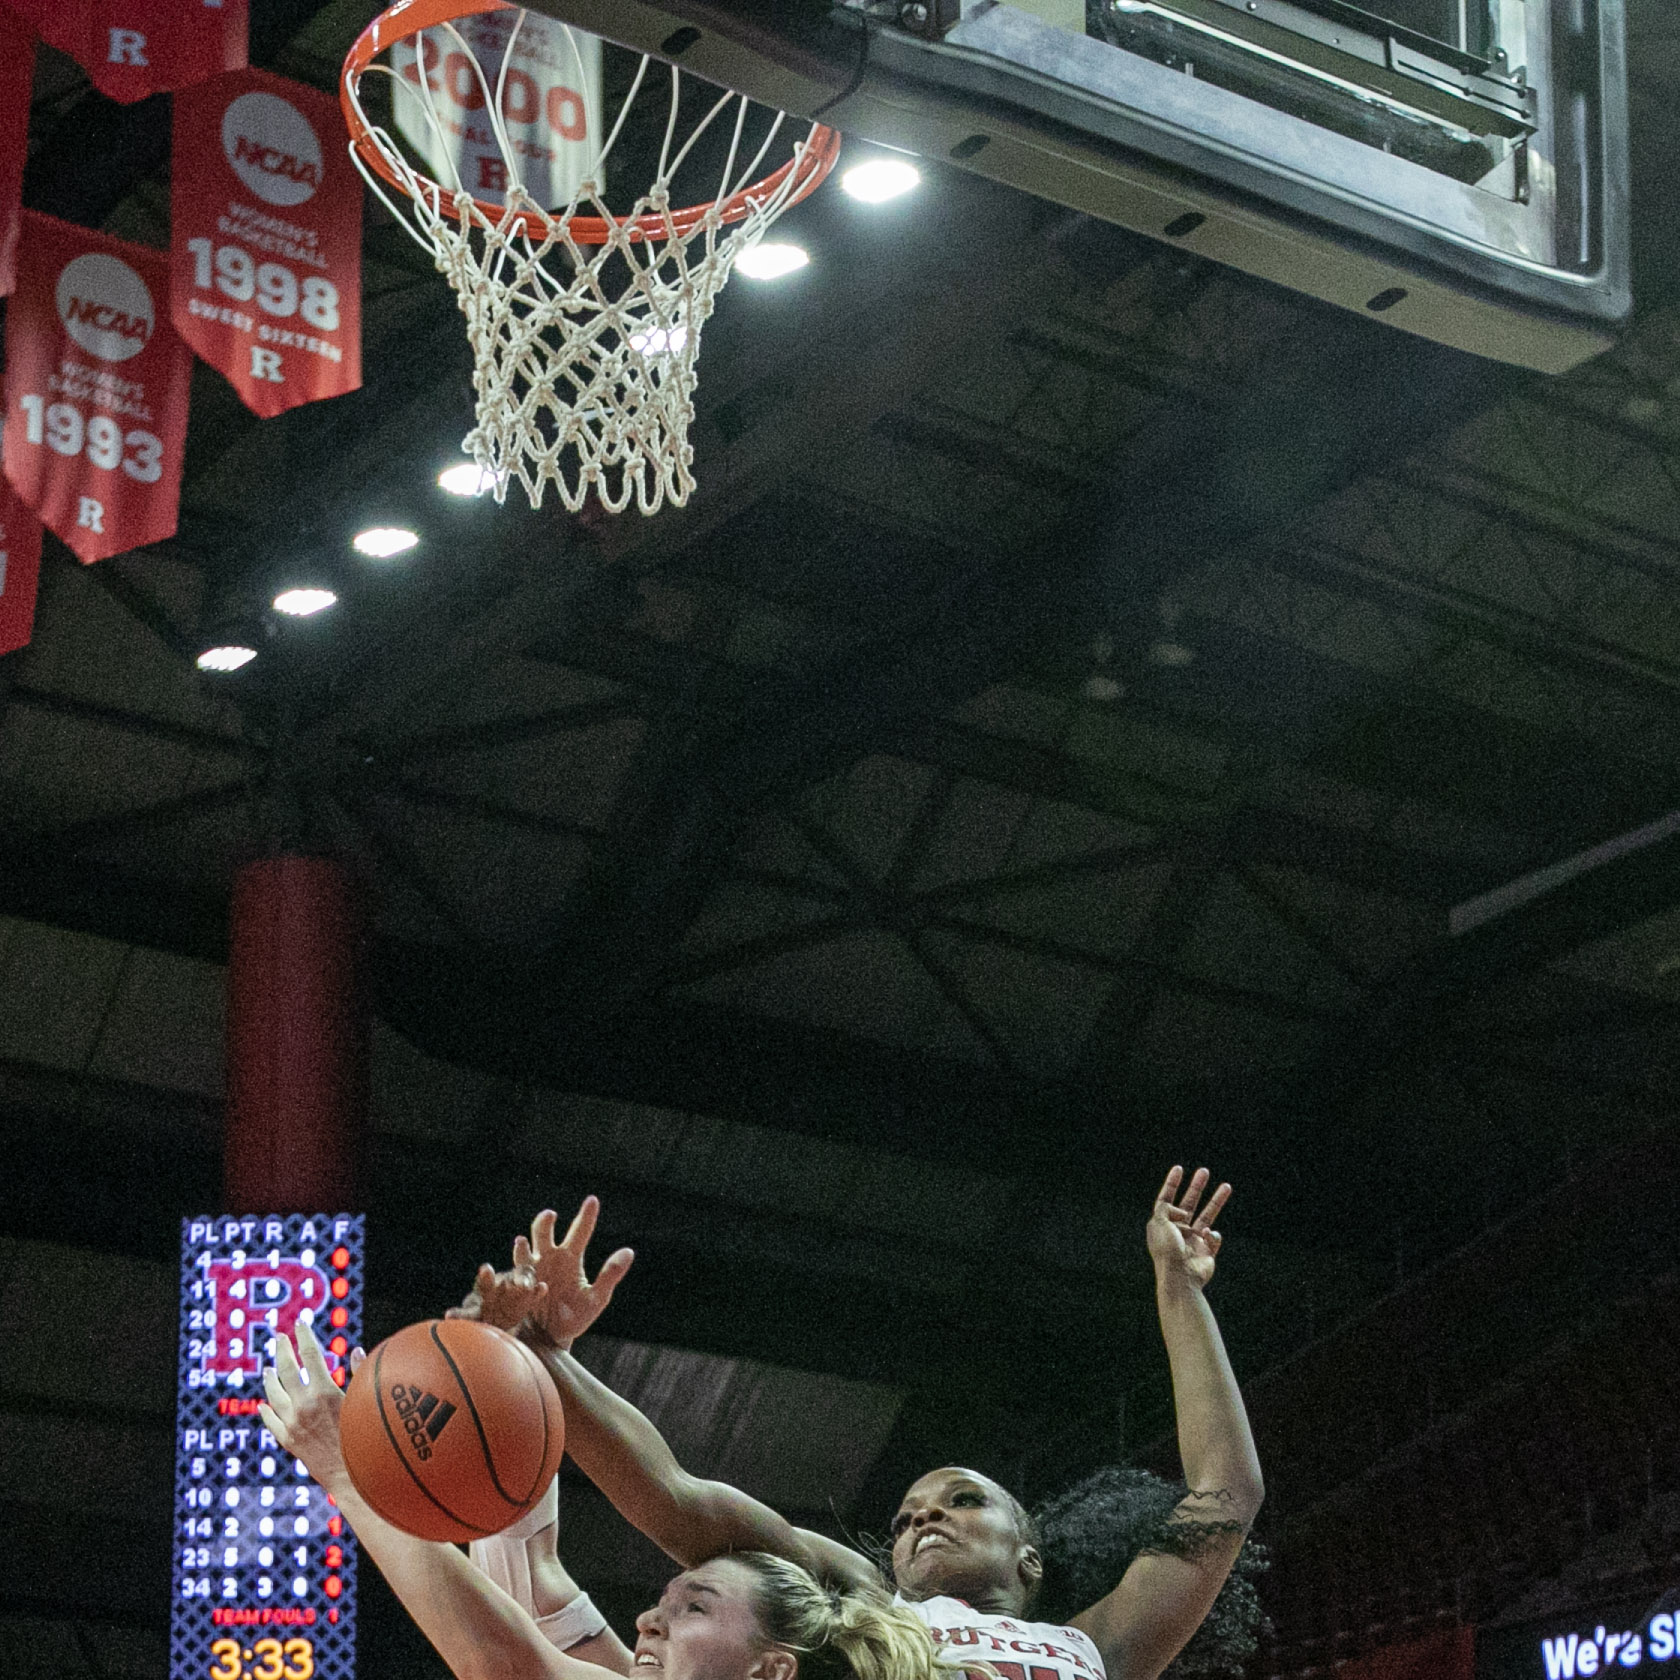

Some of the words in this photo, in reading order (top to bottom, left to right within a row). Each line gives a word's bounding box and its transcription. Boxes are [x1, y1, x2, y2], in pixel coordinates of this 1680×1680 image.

[107, 27, 149, 67] R
[401, 35, 587, 141] 2000
[235, 134, 323, 188] NCAA
[187, 237, 340, 331] 1998
[66, 296, 151, 342] NCAA
[249, 345, 286, 383] R
[21, 393, 163, 483] 1993
[76, 496, 105, 534] R
[189, 1222, 219, 1244] PL
[224, 1222, 256, 1243] PT
[265, 1222, 283, 1243] R
[300, 1221, 317, 1242] A
[333, 1221, 350, 1242] F
[196, 1250, 212, 1268] 4
[191, 1280, 217, 1298] 11
[229, 1279, 247, 1299] 4
[189, 1310, 217, 1329] 20
[189, 1339, 217, 1358] 24
[188, 1369, 217, 1388] 54
[227, 1368, 244, 1388] 4
[390, 1383, 433, 1462] adidas
[184, 1430, 213, 1450] PL
[219, 1429, 251, 1449] PT
[191, 1457, 207, 1478] 5
[184, 1487, 213, 1508] 10
[295, 1486, 310, 1507] 2
[183, 1517, 213, 1538] 14
[224, 1516, 240, 1537] 2
[182, 1547, 211, 1568] 23
[181, 1577, 211, 1598] 34
[222, 1576, 238, 1598] 2
